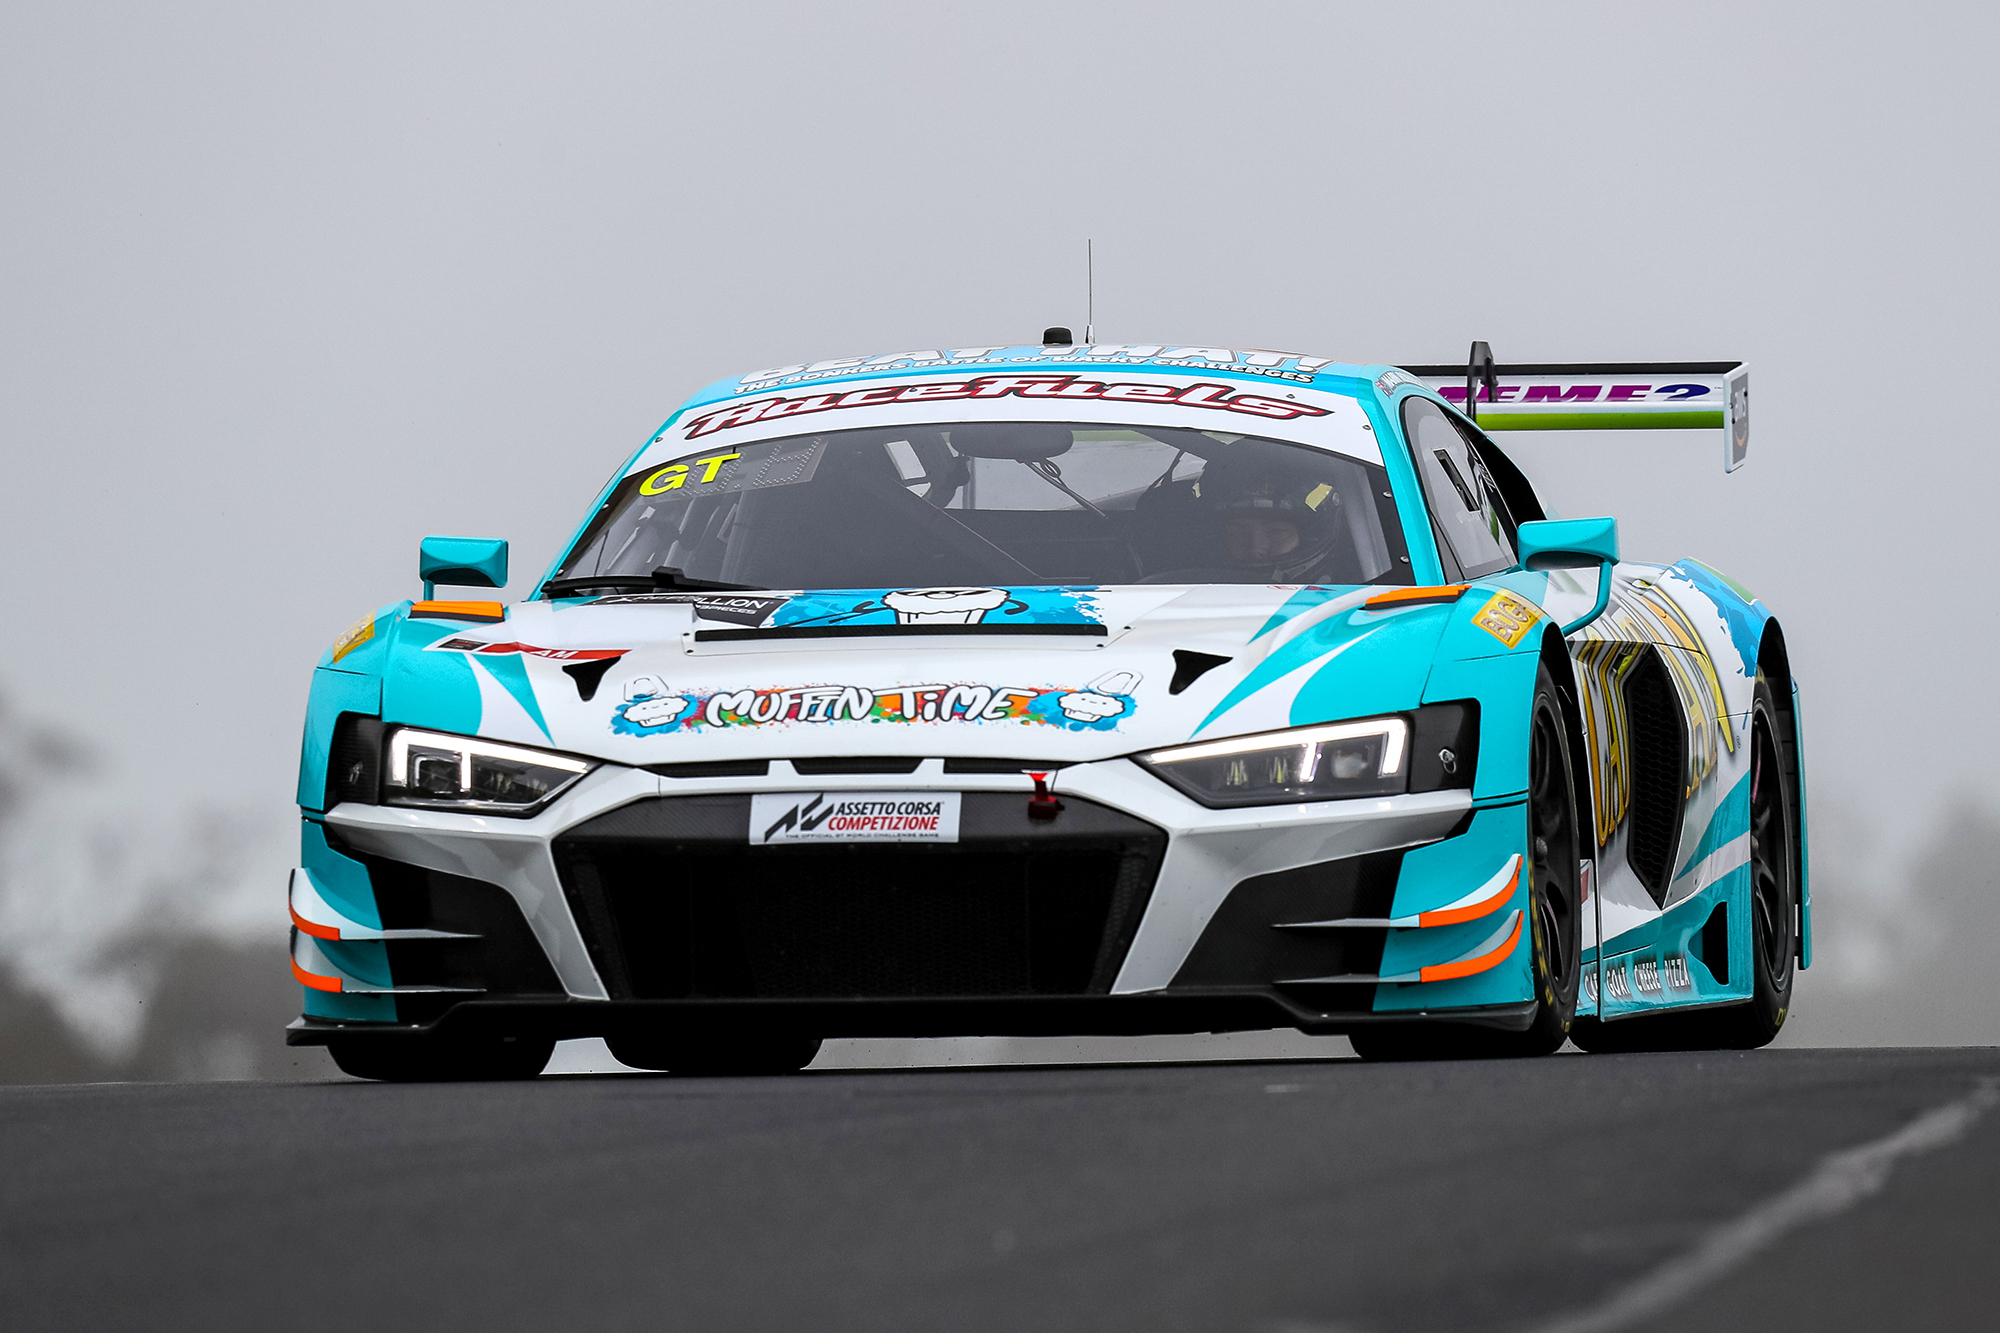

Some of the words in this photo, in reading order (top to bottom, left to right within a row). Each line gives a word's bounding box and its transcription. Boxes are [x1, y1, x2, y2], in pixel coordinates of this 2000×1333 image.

[734, 378, 783, 395] THE
[785, 363, 909, 384] BONKERS
[912, 357, 1007, 368] BATTLE
[1051, 356, 1151, 365] WACKY
[1153, 359, 1315, 384] CHALLENGES
[639, 453, 741, 497] GT
[705, 685, 875, 729] MUFFIN
[828, 816, 940, 831] COMPETIZIONE
[835, 802, 897, 816] ASSETTO
[897, 802, 941, 816] CORSA
[1606, 967, 1631, 997] GOAT
[1634, 962, 1661, 991] CHEESE
[1664, 958, 1691, 988] PIZZA
